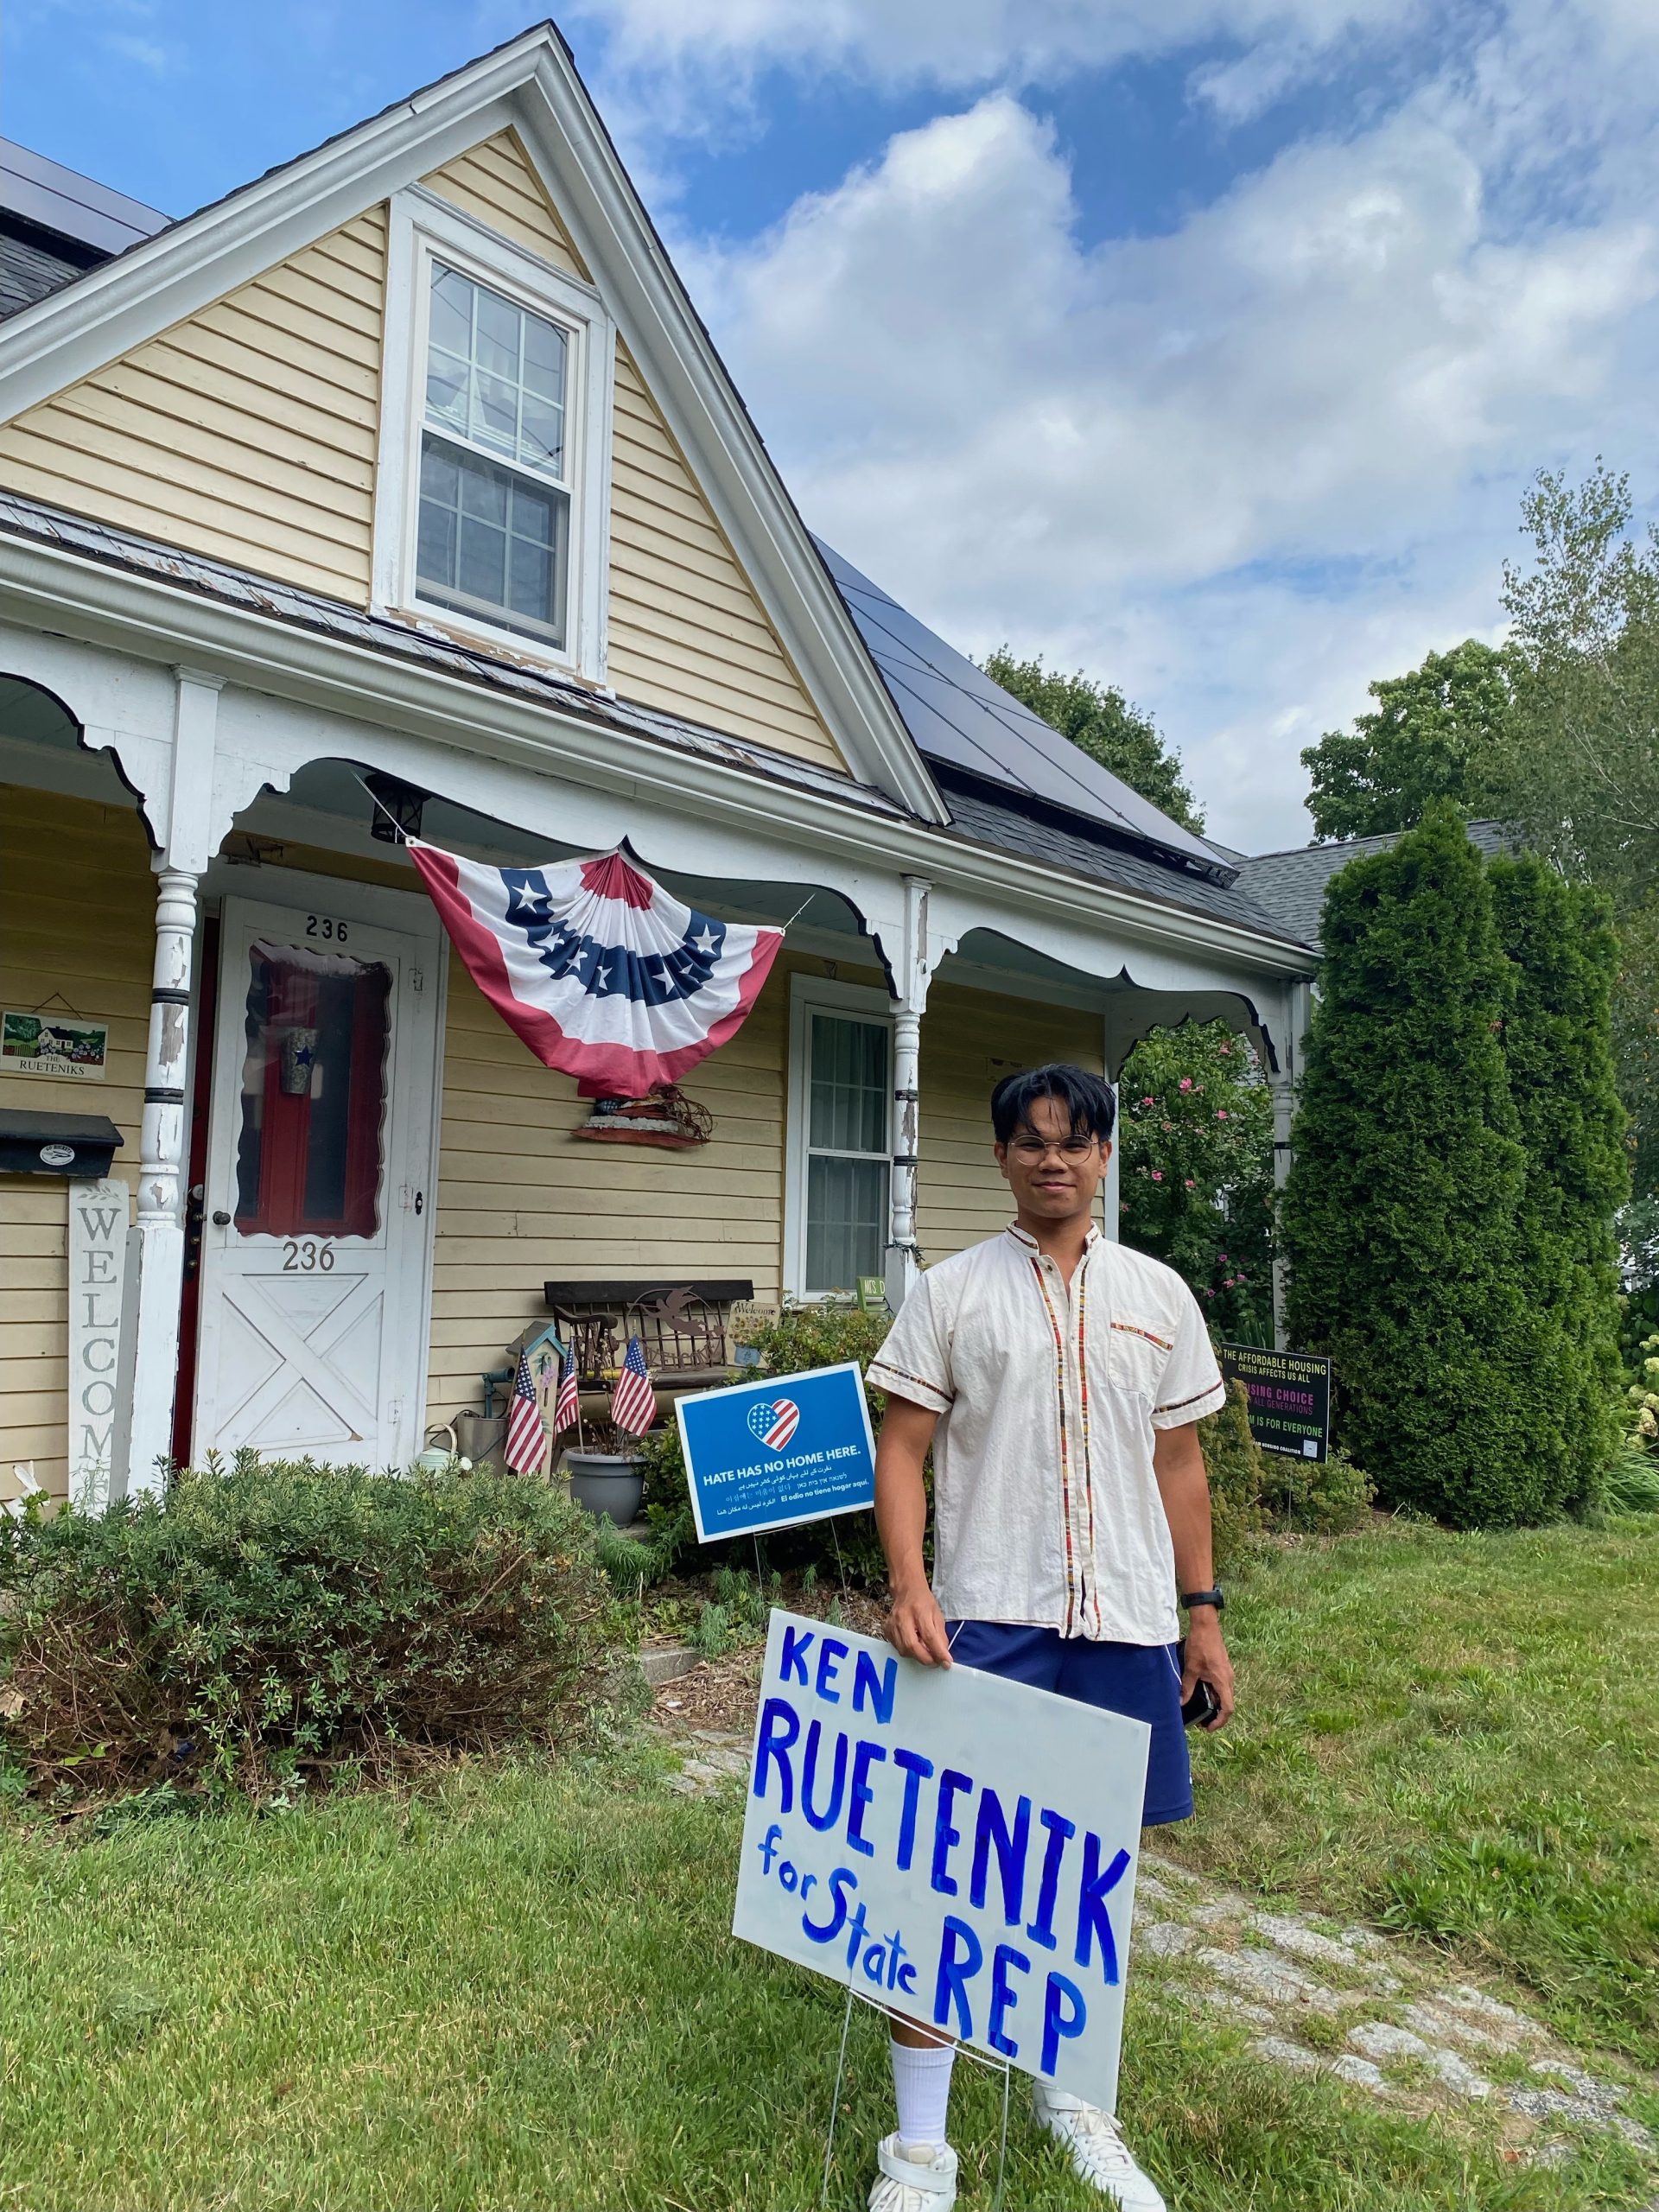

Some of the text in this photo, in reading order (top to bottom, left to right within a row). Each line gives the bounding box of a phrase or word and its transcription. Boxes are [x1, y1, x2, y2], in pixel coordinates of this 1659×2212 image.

[307, 915, 348, 942] 236
[20, 1060, 85, 1076] RUETENIKS
[283, 1241, 334, 1271] 236
[735, 1302, 776, 1315] Welcome
[1224, 1350, 1326, 1376] THE AFFORDABLE HOUSING
[1238, 1363, 1310, 1382] CRISIS AFFECTS US ALL
[1255, 1398, 1264, 1407] ALL
[1268, 1401, 1313, 1415] GENERATIONS
[1276, 1389, 1313, 1405] CHOICE
[1256, 1417, 1263, 1426] IS
[1266, 1418, 1281, 1430] FOR
[1282, 1421, 1323, 1438] EVERYONE
[1280, 1446, 1301, 1455] COALITION
[703, 1445, 861, 1486] HATE HAS NO HOME HERE.
[789, 1492, 804, 1501] odio
[779, 1626, 898, 1724] KEN
[753, 1697, 1131, 1986] RUETENIK
[758, 1824, 1088, 2076] for State REP
